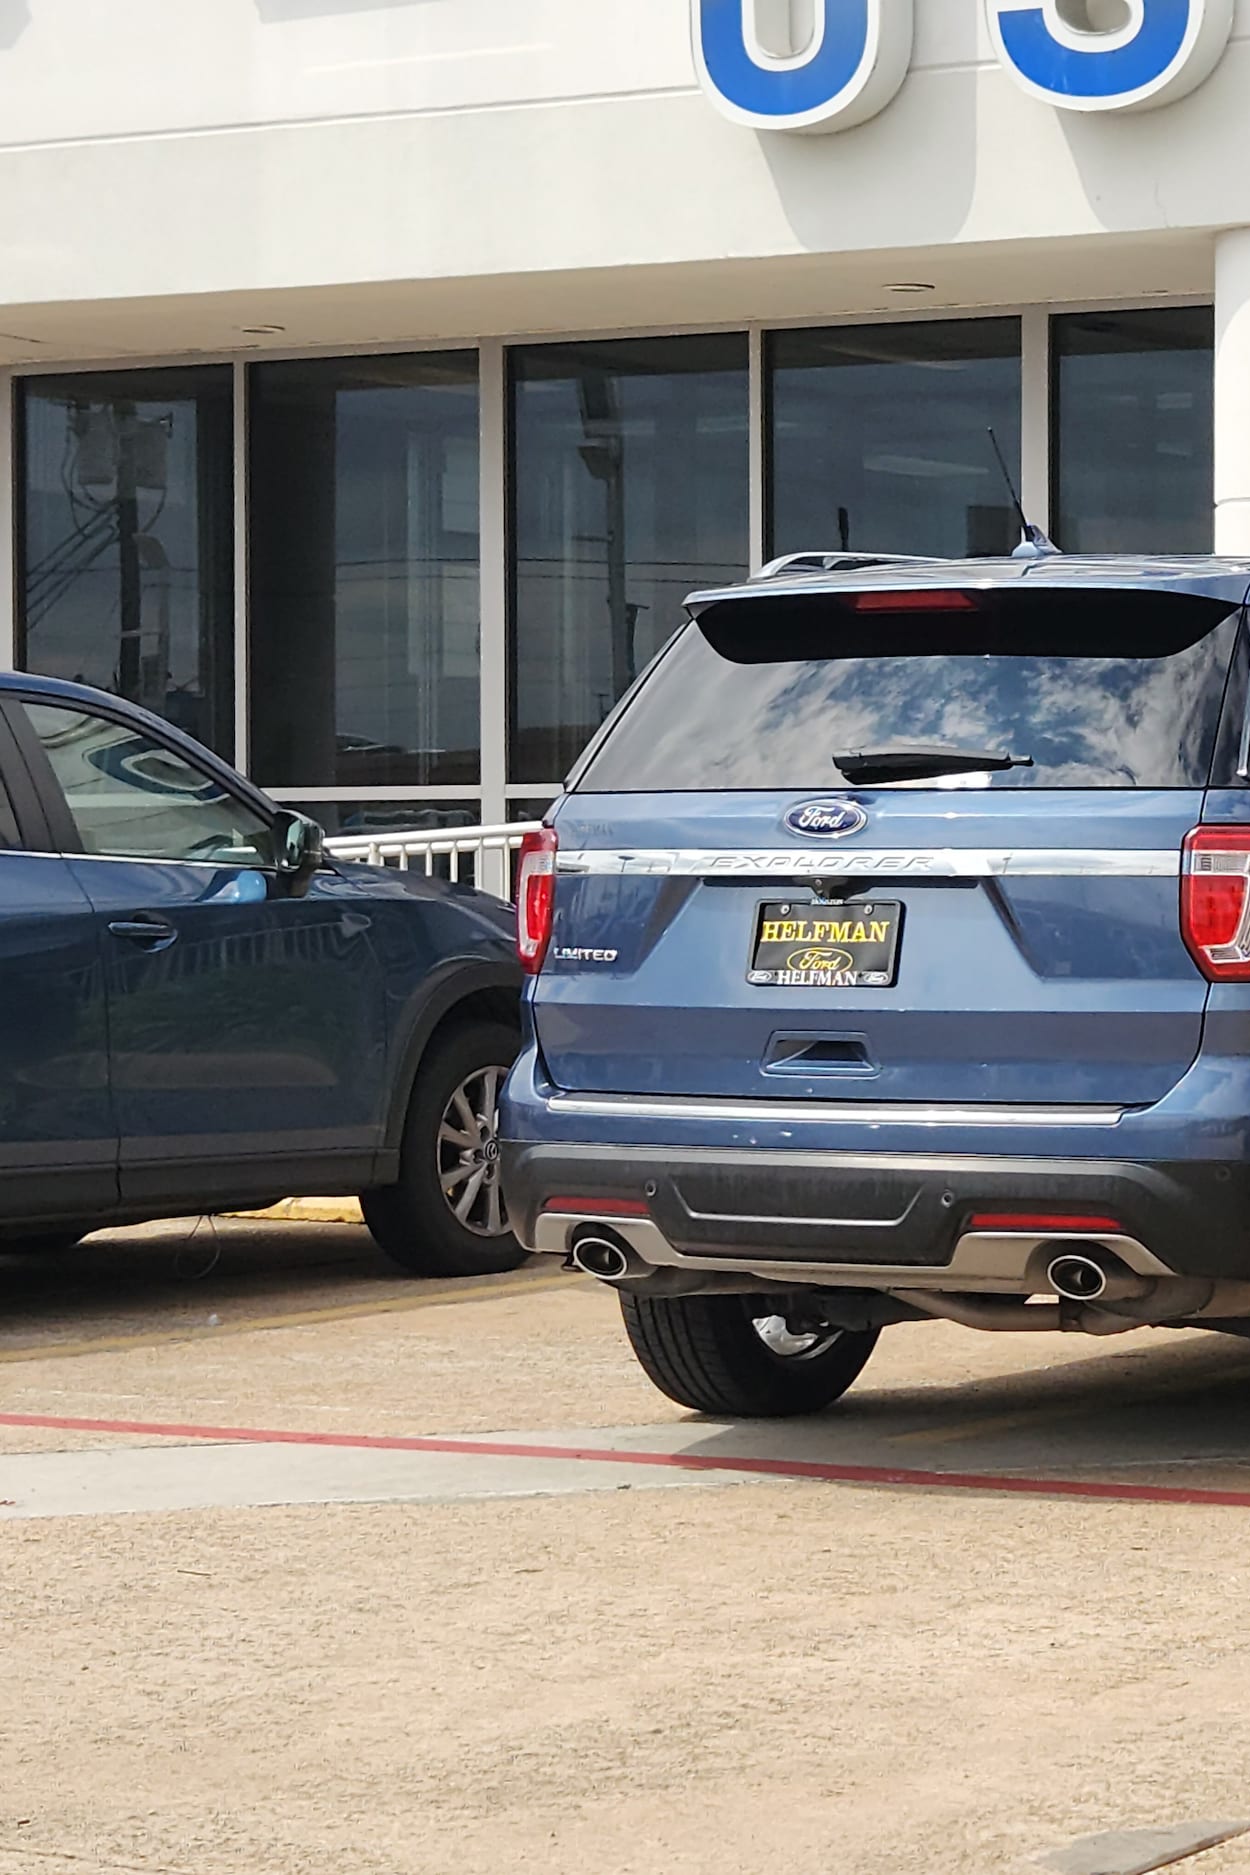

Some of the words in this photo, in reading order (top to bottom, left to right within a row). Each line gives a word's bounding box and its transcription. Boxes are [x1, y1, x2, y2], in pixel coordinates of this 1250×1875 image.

[798, 805, 847, 829] Ford
[710, 855, 934, 870] EXPLORER
[760, 920, 890, 943] HELFMAN
[553, 947, 618, 962] LIMITED
[799, 950, 841, 971] Ford
[776, 969, 858, 986] HELFMAN
